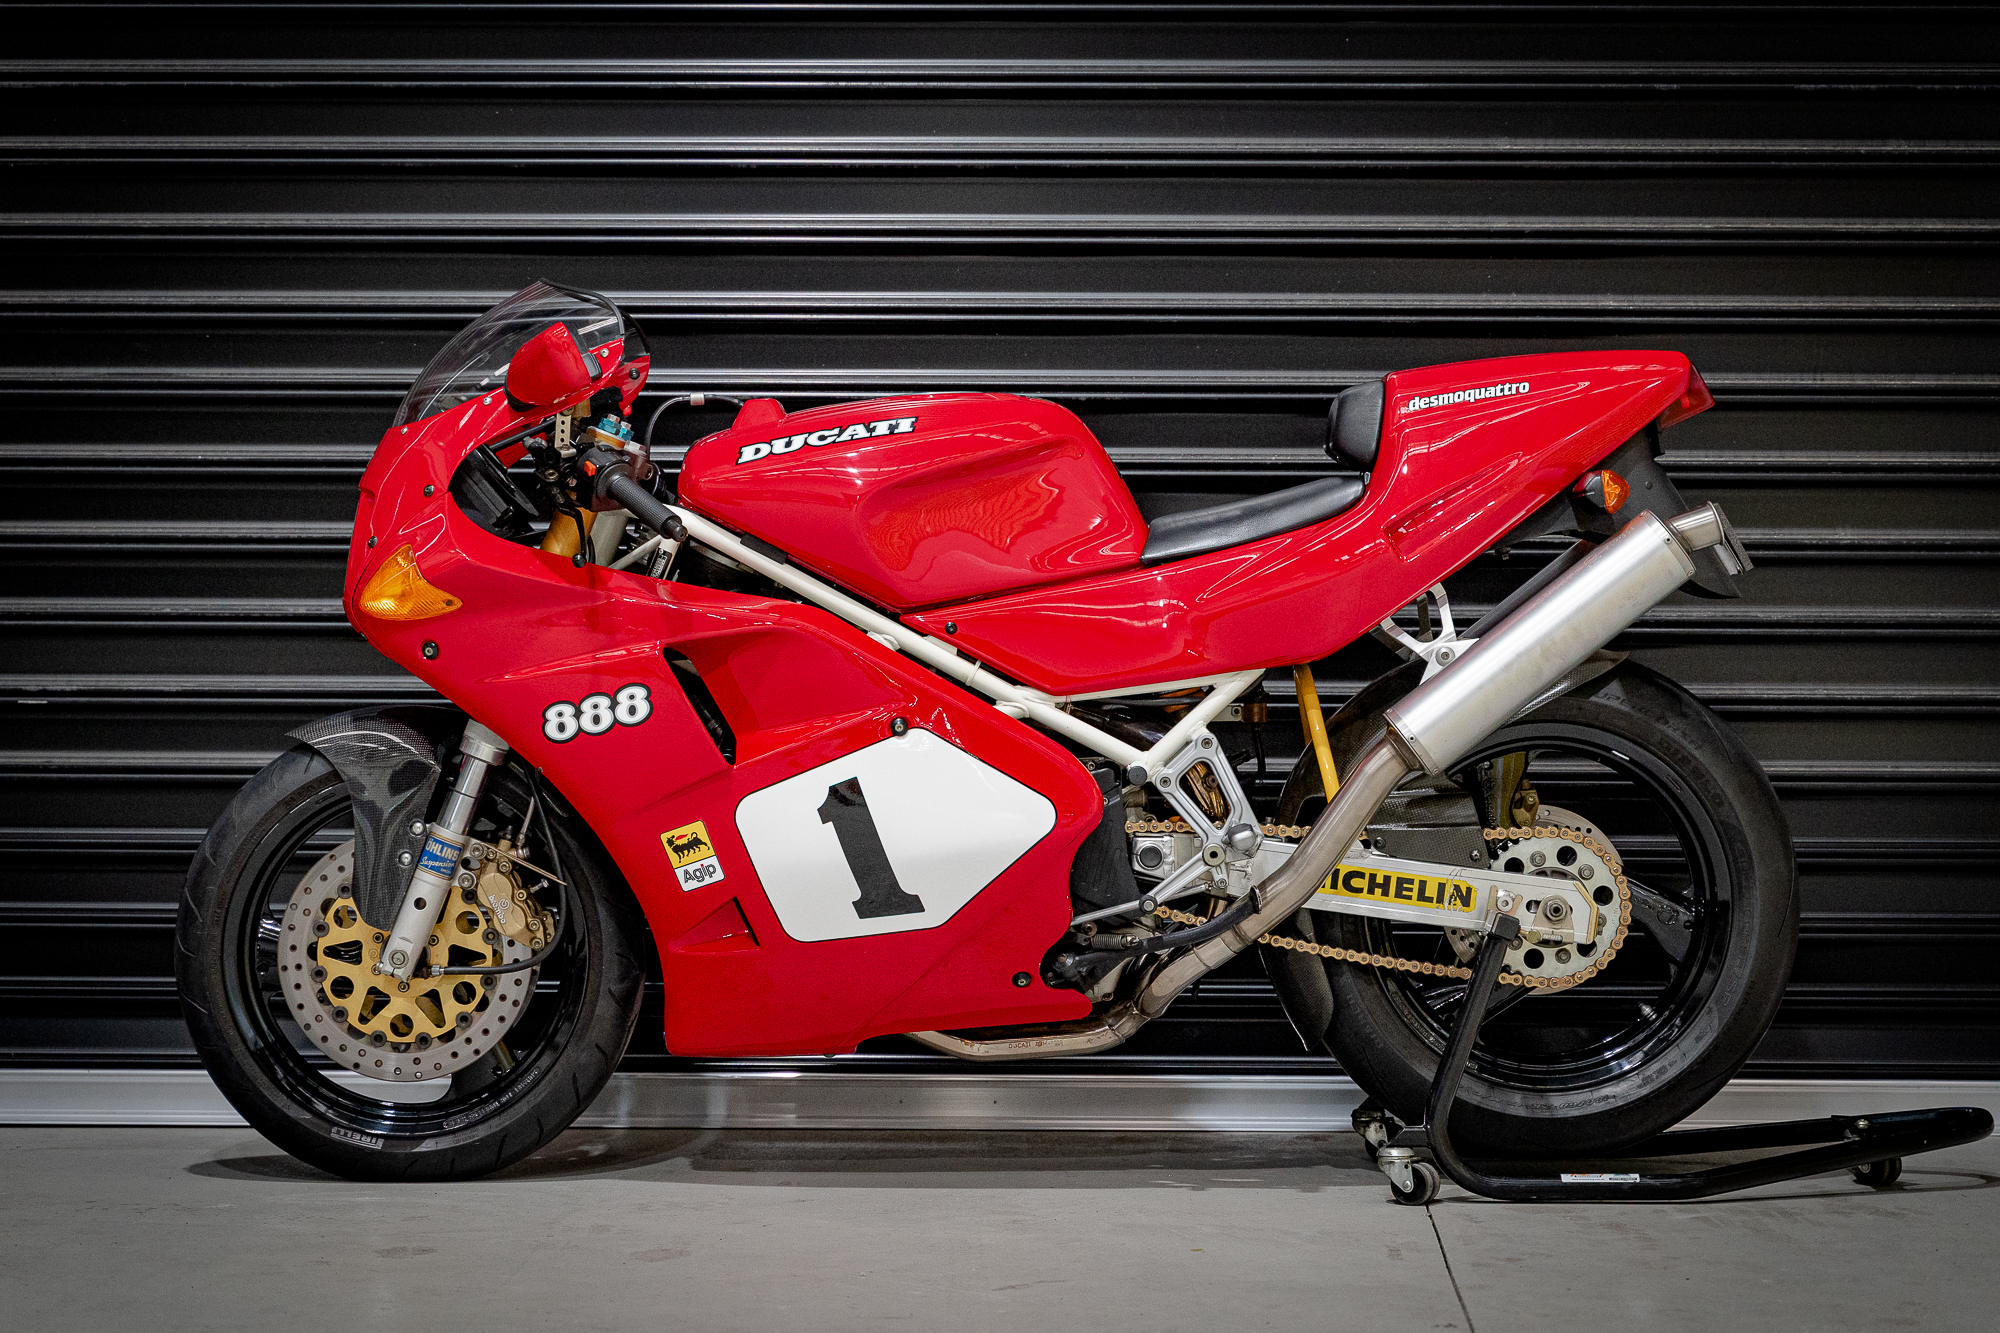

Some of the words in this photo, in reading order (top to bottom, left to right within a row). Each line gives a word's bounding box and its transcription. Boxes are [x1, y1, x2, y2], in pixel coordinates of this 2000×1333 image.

[1408, 382, 1530, 412] desmoquattro
[735, 416, 919, 466] DUCATI
[542, 683, 654, 744] 888
[817, 777, 925, 919] 1
[683, 863, 717, 884] Agip
[1322, 868, 1474, 908] ICHELIN
[488, 894, 506, 924] brembo
[331, 1126, 385, 1150] PIRELLI
